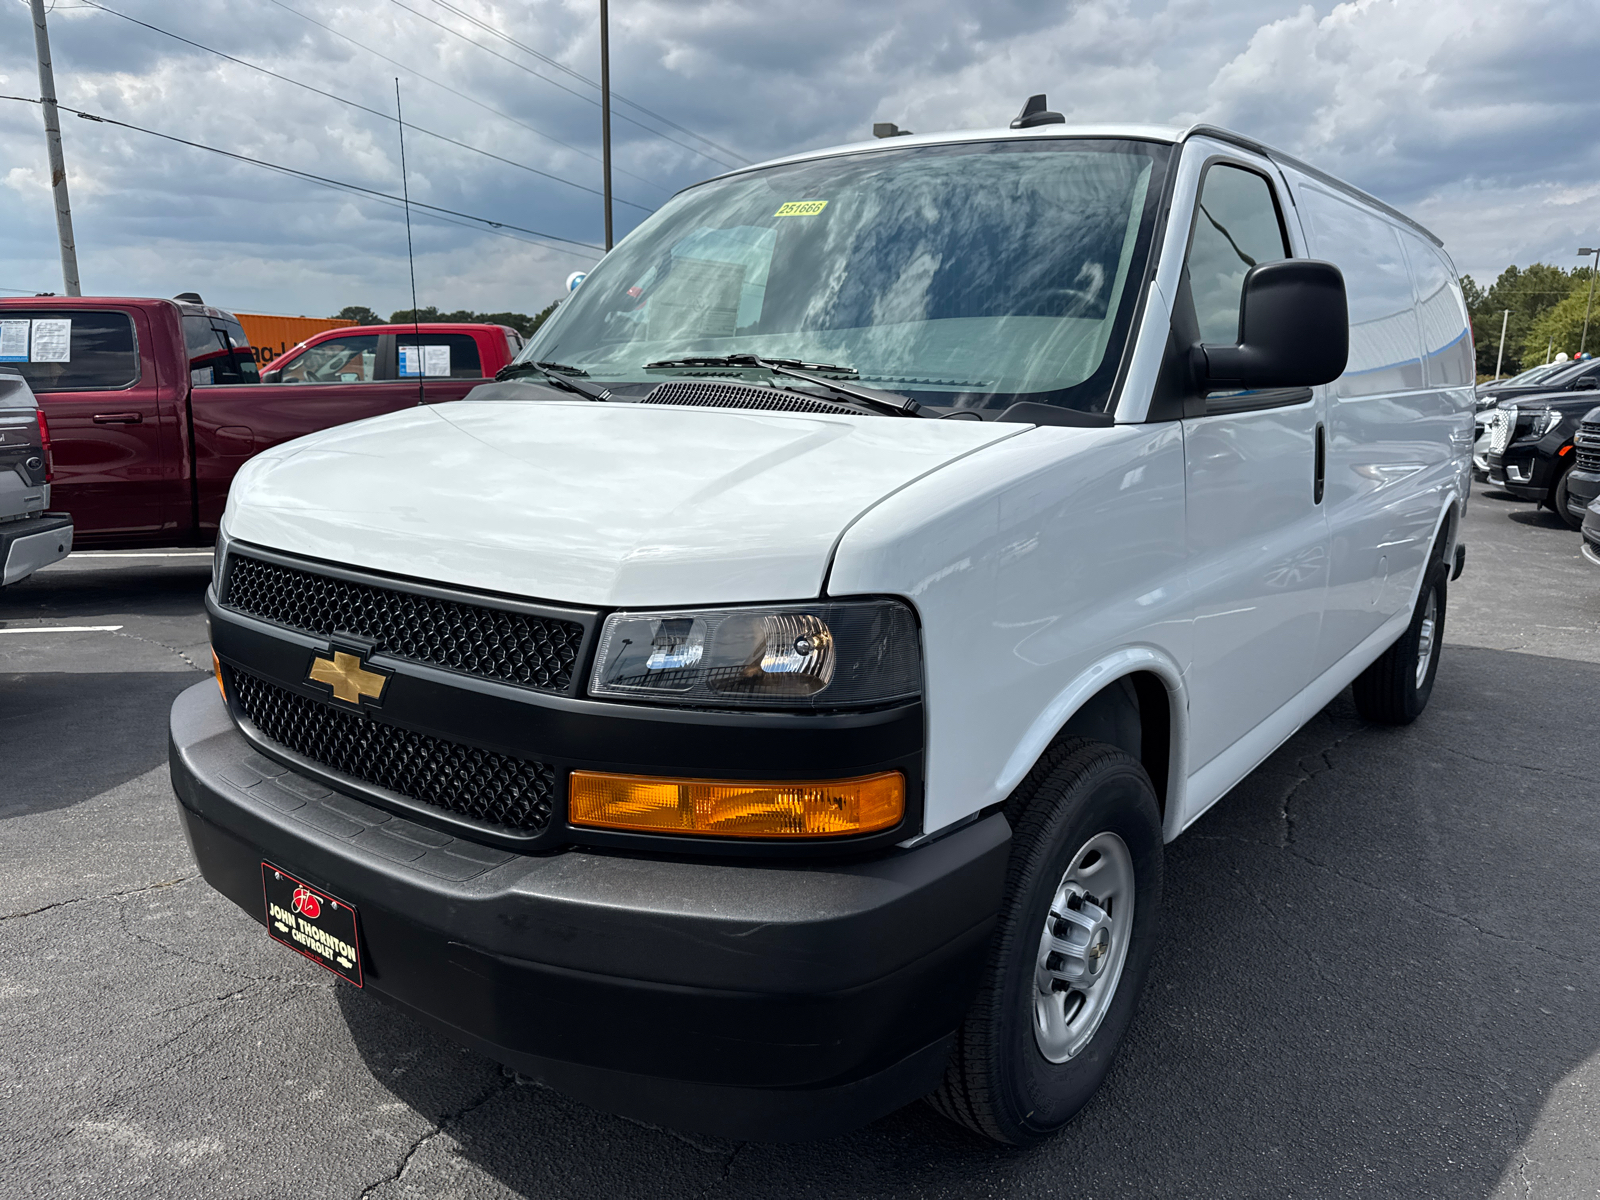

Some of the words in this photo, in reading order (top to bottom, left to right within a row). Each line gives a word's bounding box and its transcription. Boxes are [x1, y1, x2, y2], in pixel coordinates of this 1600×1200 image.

[778, 203, 823, 214] 251666
[269, 902, 297, 929] JOHN
[297, 917, 357, 963] THORNTON
[291, 928, 334, 961] CHEVROLET
